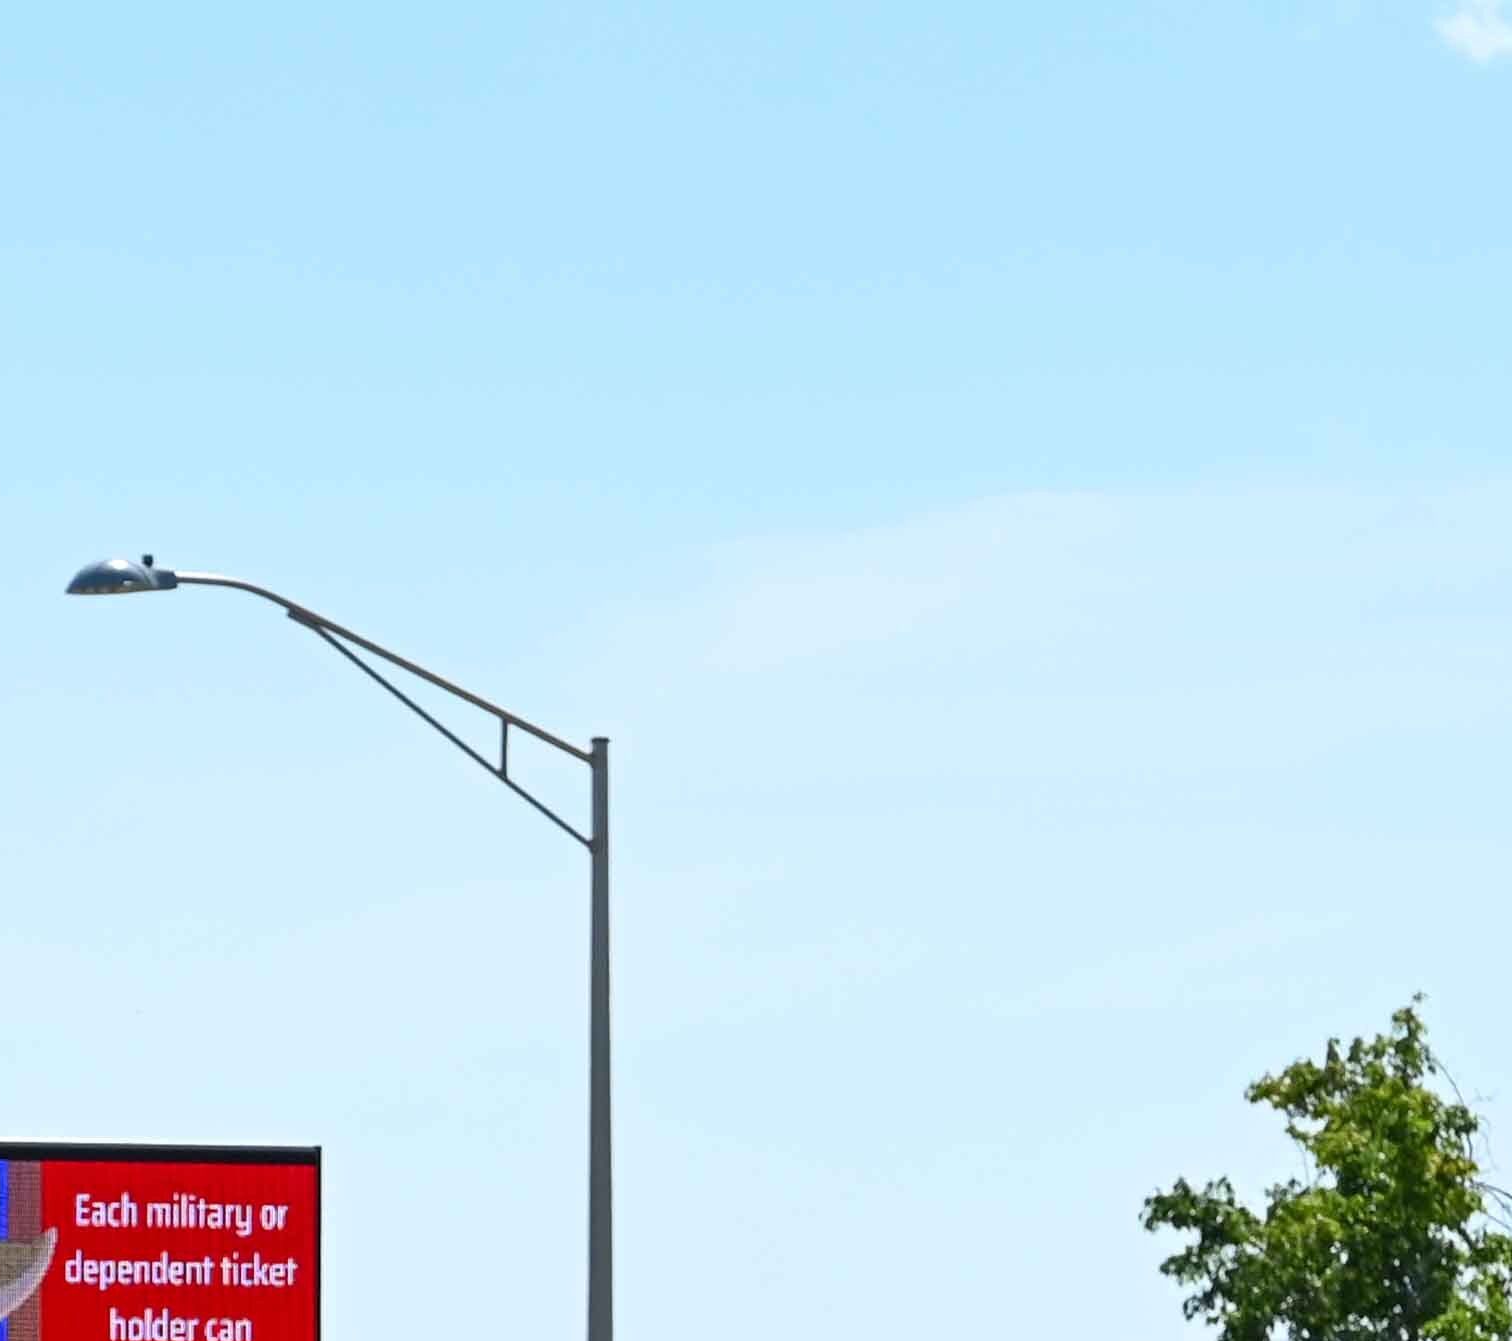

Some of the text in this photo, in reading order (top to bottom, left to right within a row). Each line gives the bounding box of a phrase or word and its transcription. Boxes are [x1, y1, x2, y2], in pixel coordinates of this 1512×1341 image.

[76, 1193, 288, 1236] Each military or
[66, 1250, 297, 1290] dependent ticket
[110, 1308, 251, 1341] holder can
